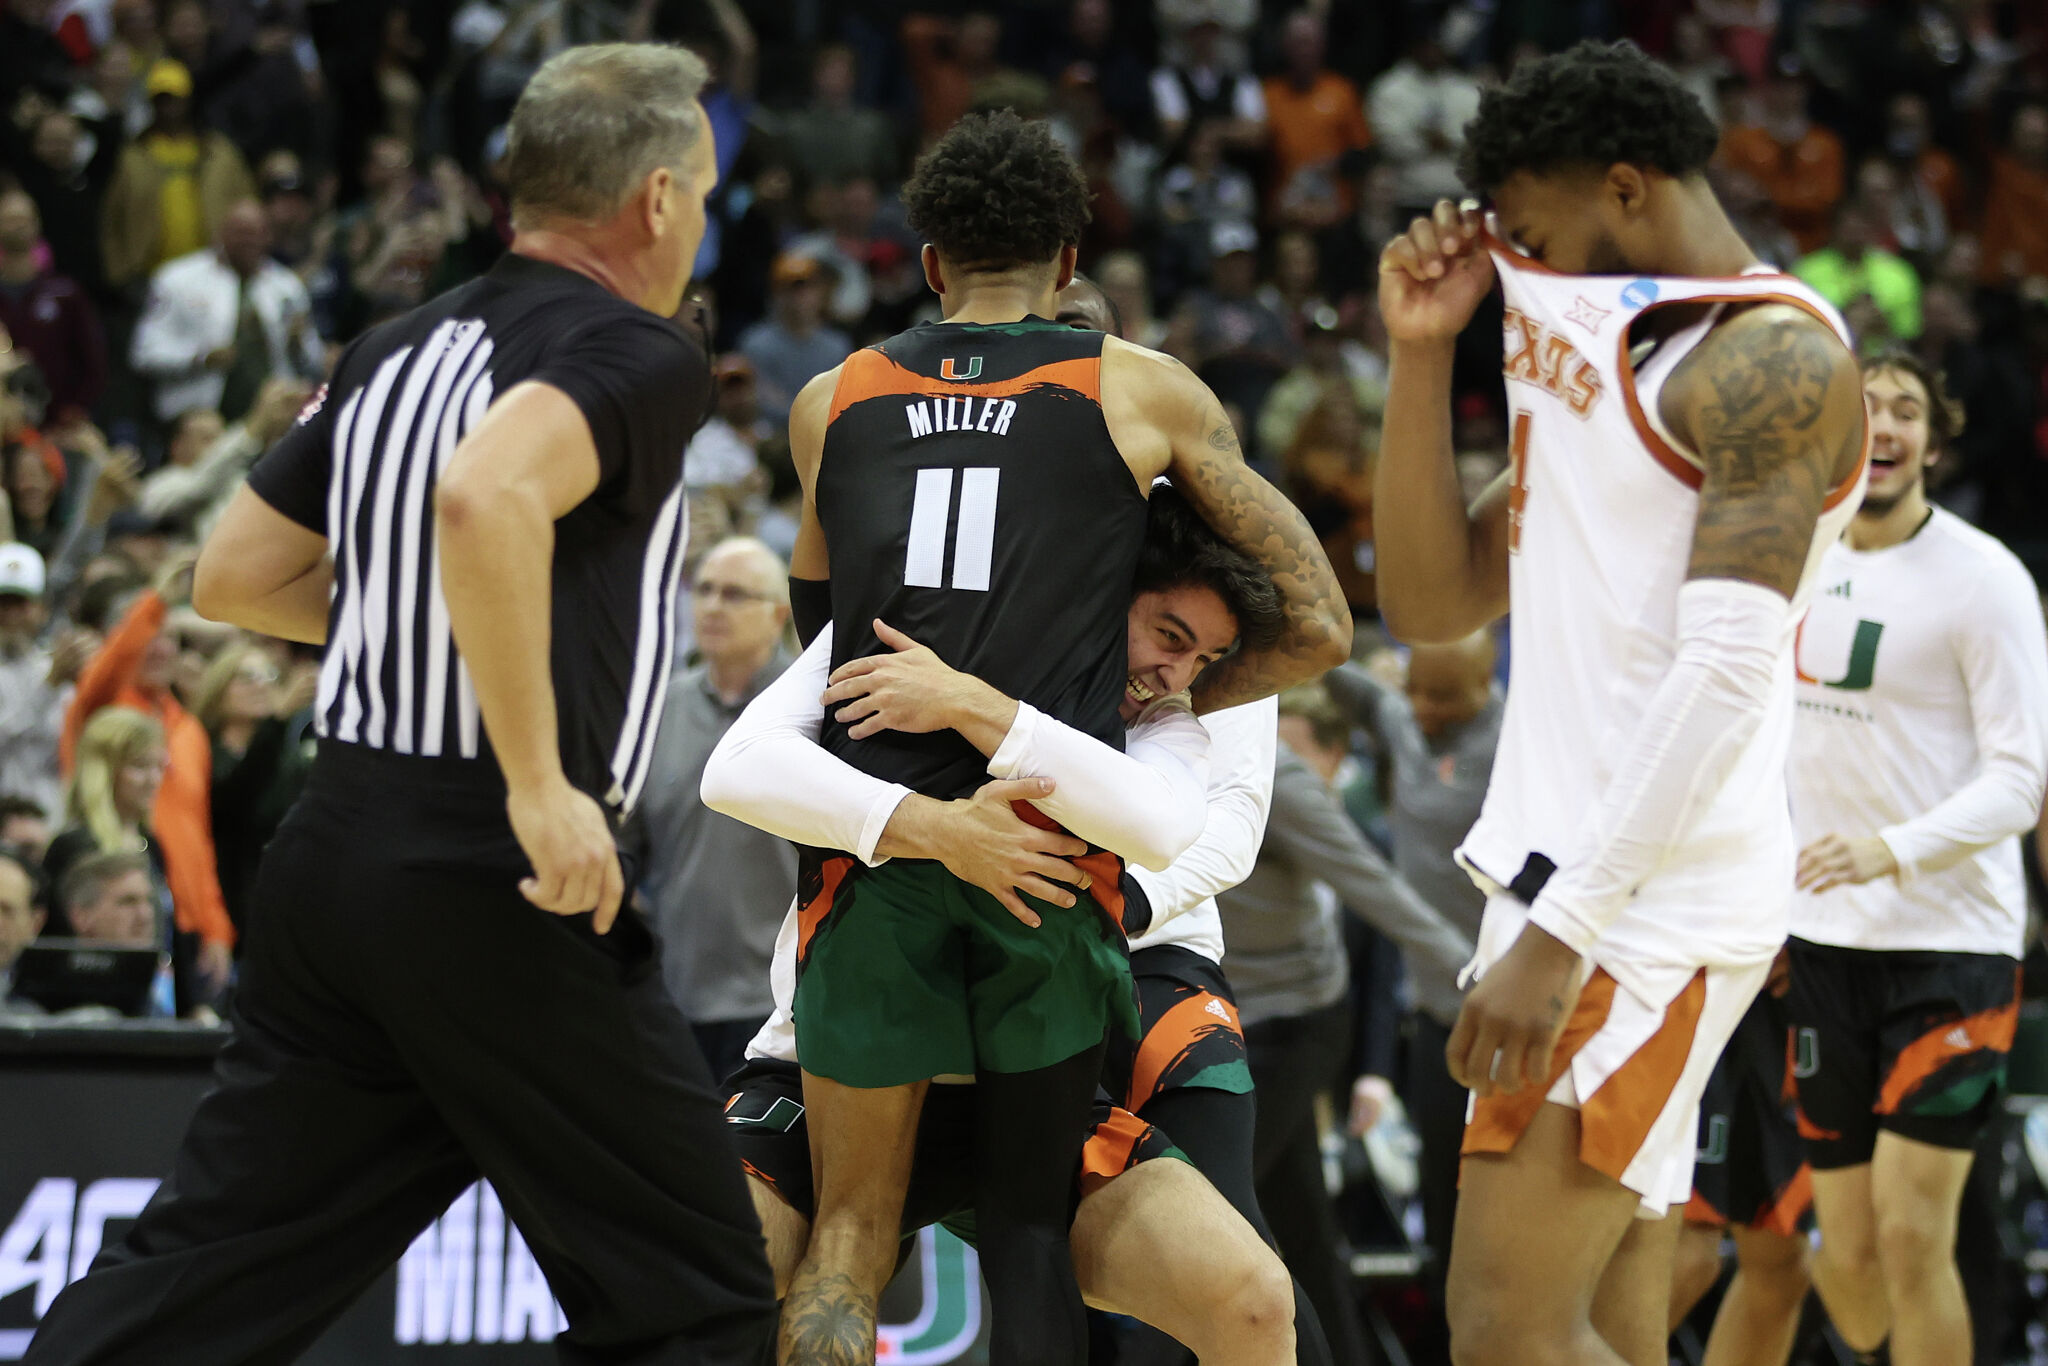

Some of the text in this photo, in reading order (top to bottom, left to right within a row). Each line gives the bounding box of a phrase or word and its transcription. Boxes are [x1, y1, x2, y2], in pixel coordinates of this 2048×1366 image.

[905, 396, 1017, 439] MILLER
[904, 467, 1000, 592] 11
[395, 1177, 569, 1344] MIA
